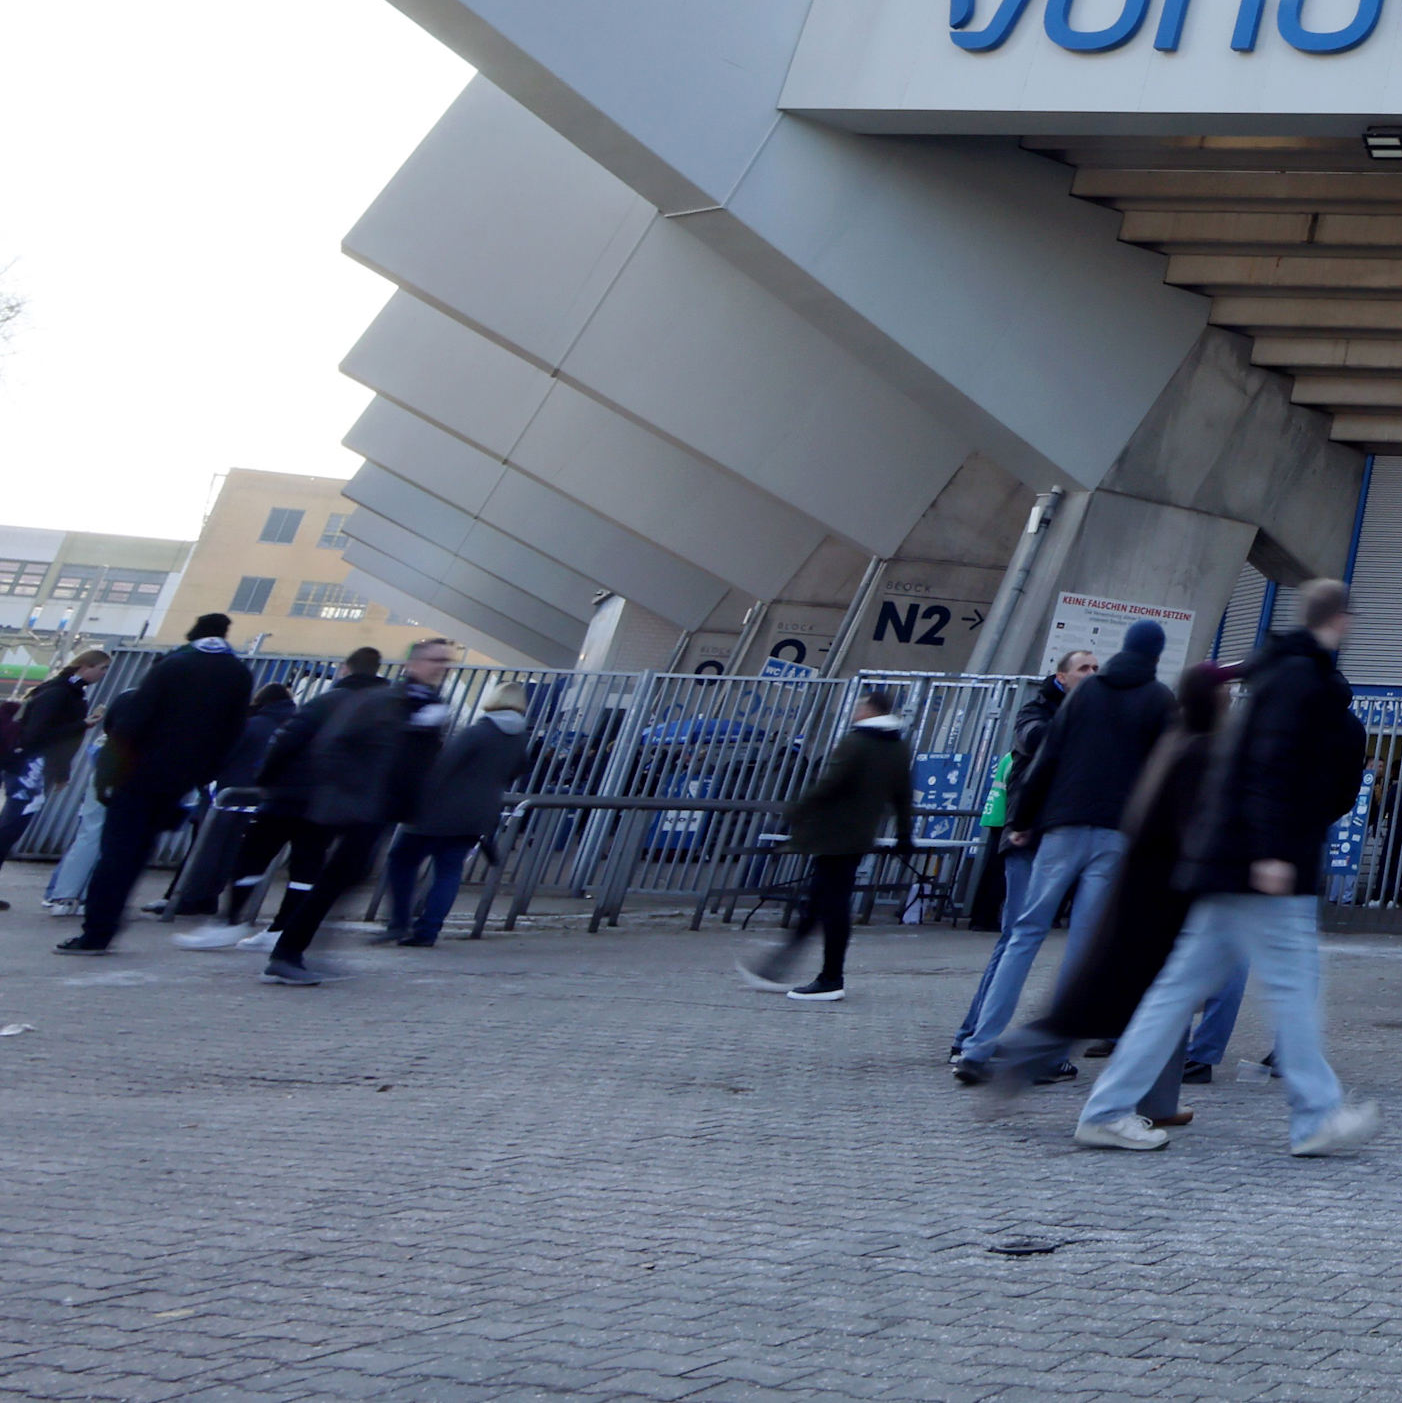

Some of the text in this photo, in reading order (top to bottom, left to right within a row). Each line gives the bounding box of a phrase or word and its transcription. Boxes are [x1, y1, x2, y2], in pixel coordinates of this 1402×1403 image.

[886, 581, 933, 593] BLOCK
[1062, 596, 1192, 621] KEINE FALSCHEN ZEICHEN SETZEN!
[777, 621, 815, 631] BLOCK
[873, 601, 951, 646] N2
[765, 666, 781, 676] WC
